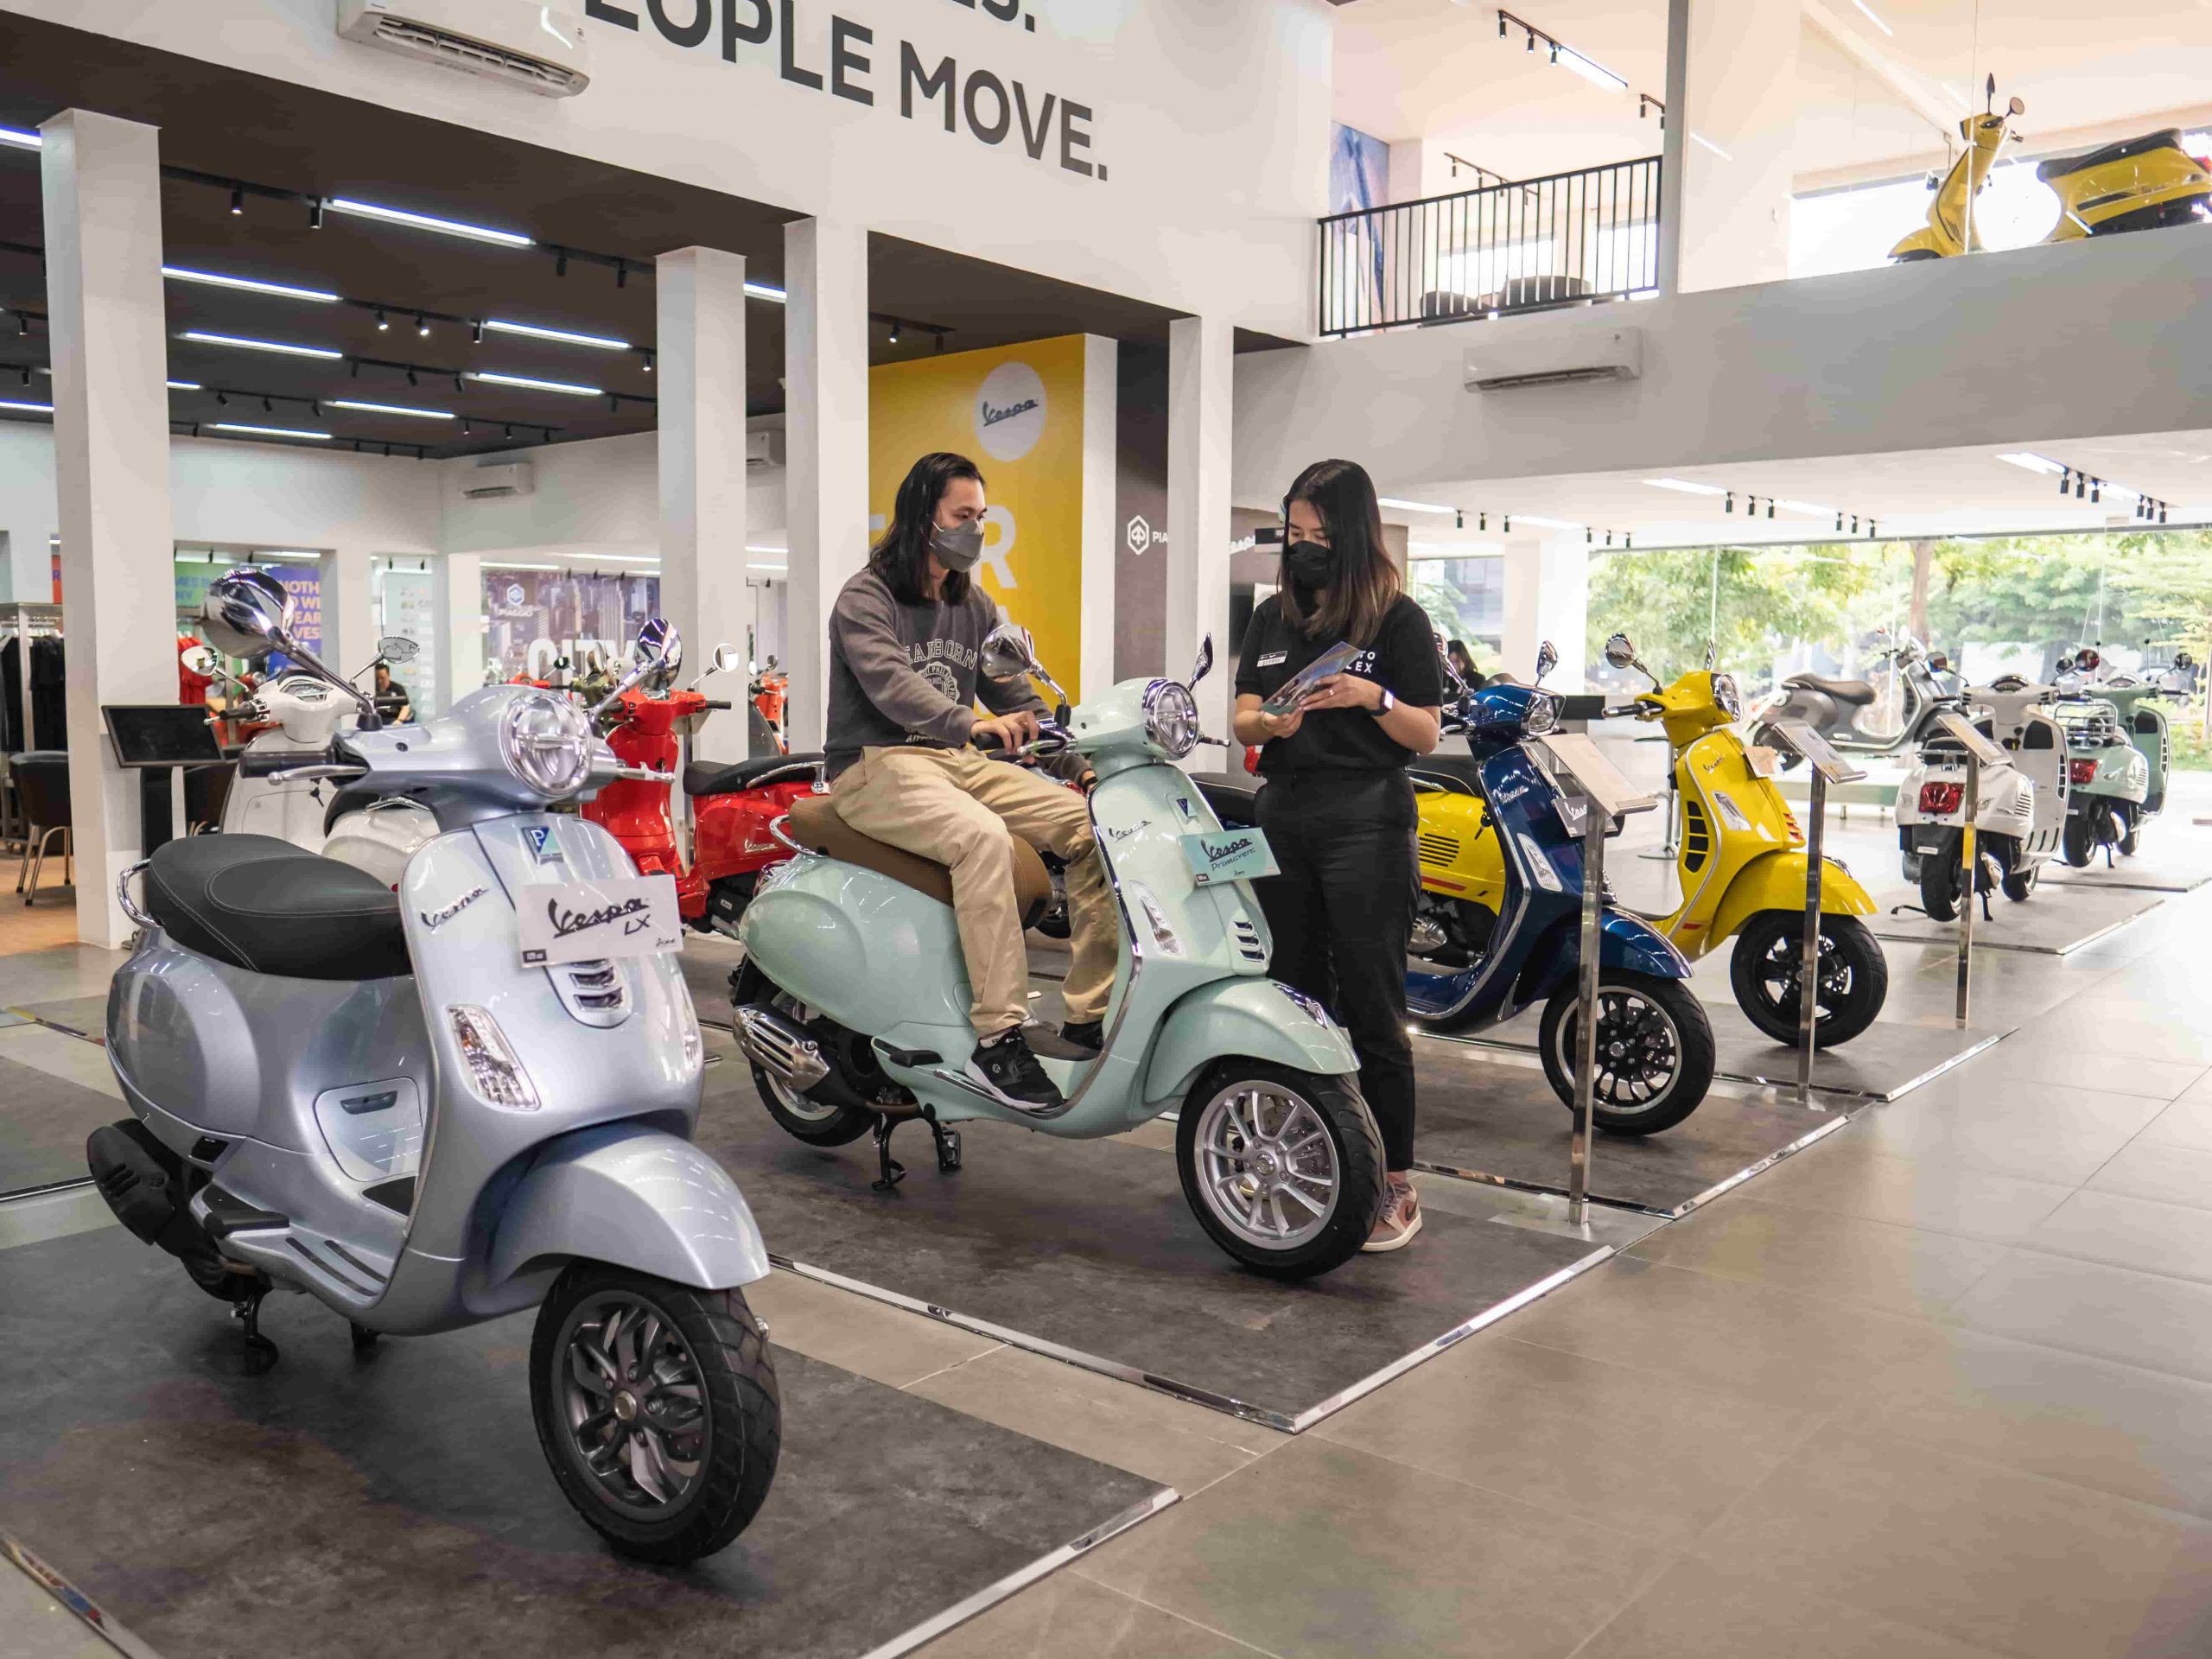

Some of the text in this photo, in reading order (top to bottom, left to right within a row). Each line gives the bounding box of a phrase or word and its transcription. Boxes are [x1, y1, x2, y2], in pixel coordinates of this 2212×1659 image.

[585, 0, 1108, 181] OPLE MOVE.
[982, 400, 1039, 427] Vespa
[1201, 837, 1254, 863] Vespa
[548, 898, 650, 939] Vespa
[624, 913, 651, 936] LX
